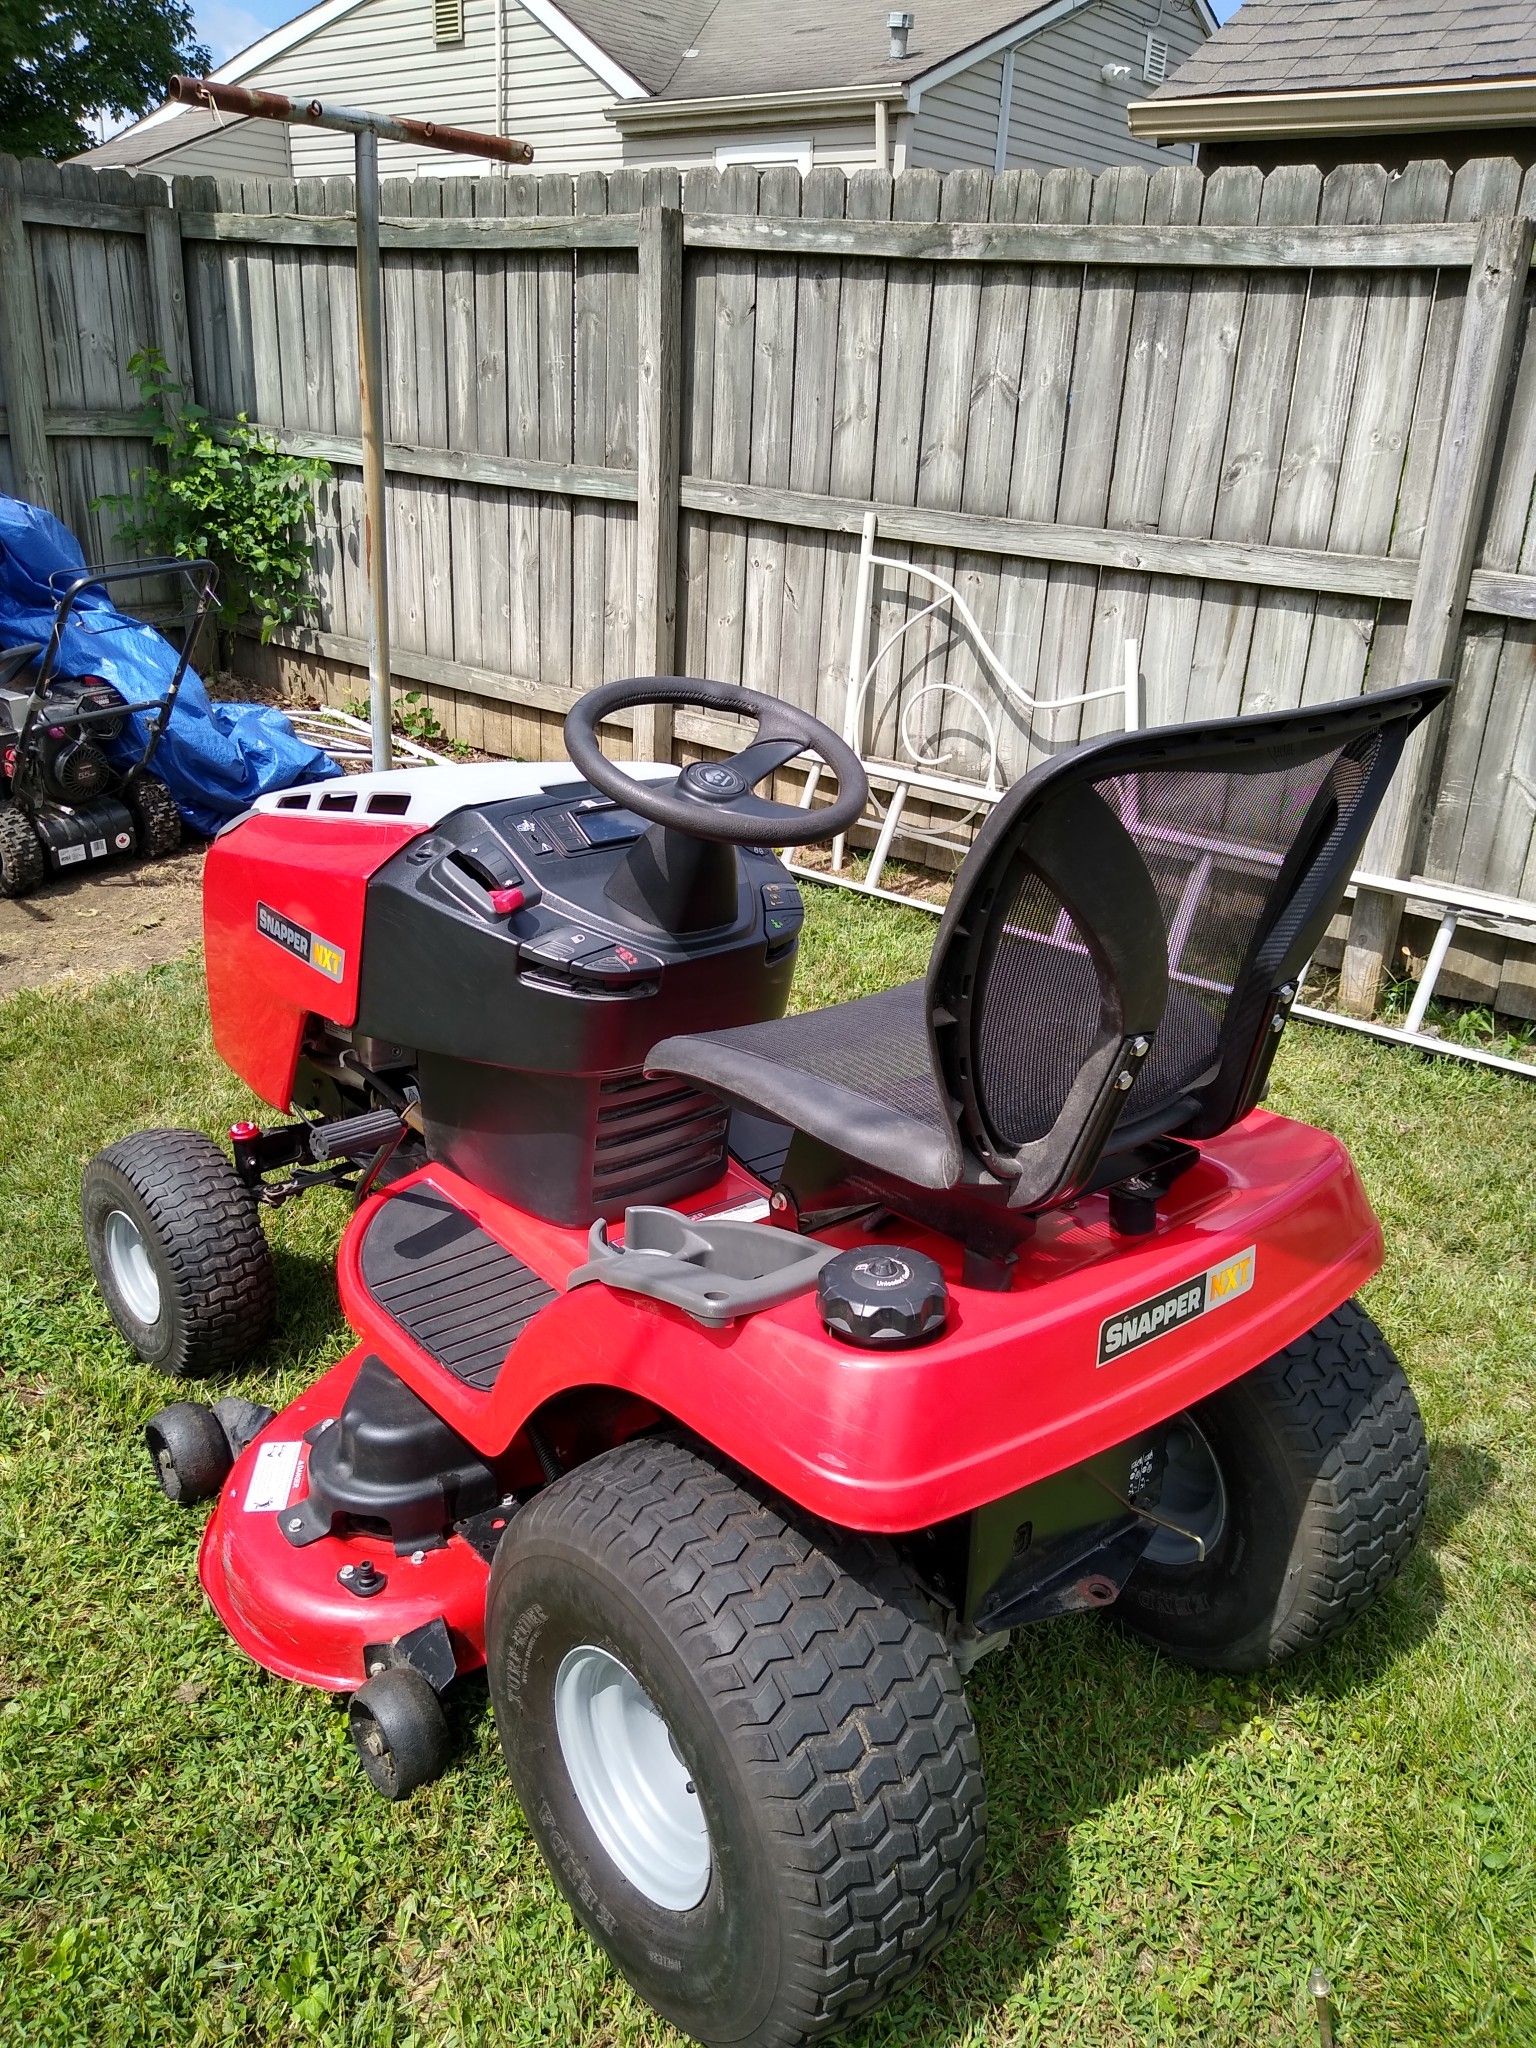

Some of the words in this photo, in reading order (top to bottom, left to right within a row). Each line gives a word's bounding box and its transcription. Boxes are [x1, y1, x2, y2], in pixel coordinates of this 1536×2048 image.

[260, 908, 308, 957] SNAPPER
[313, 942, 341, 976] NXT
[1105, 1286, 1202, 1354] SNAPPER
[1210, 1256, 1252, 1302] NXT
